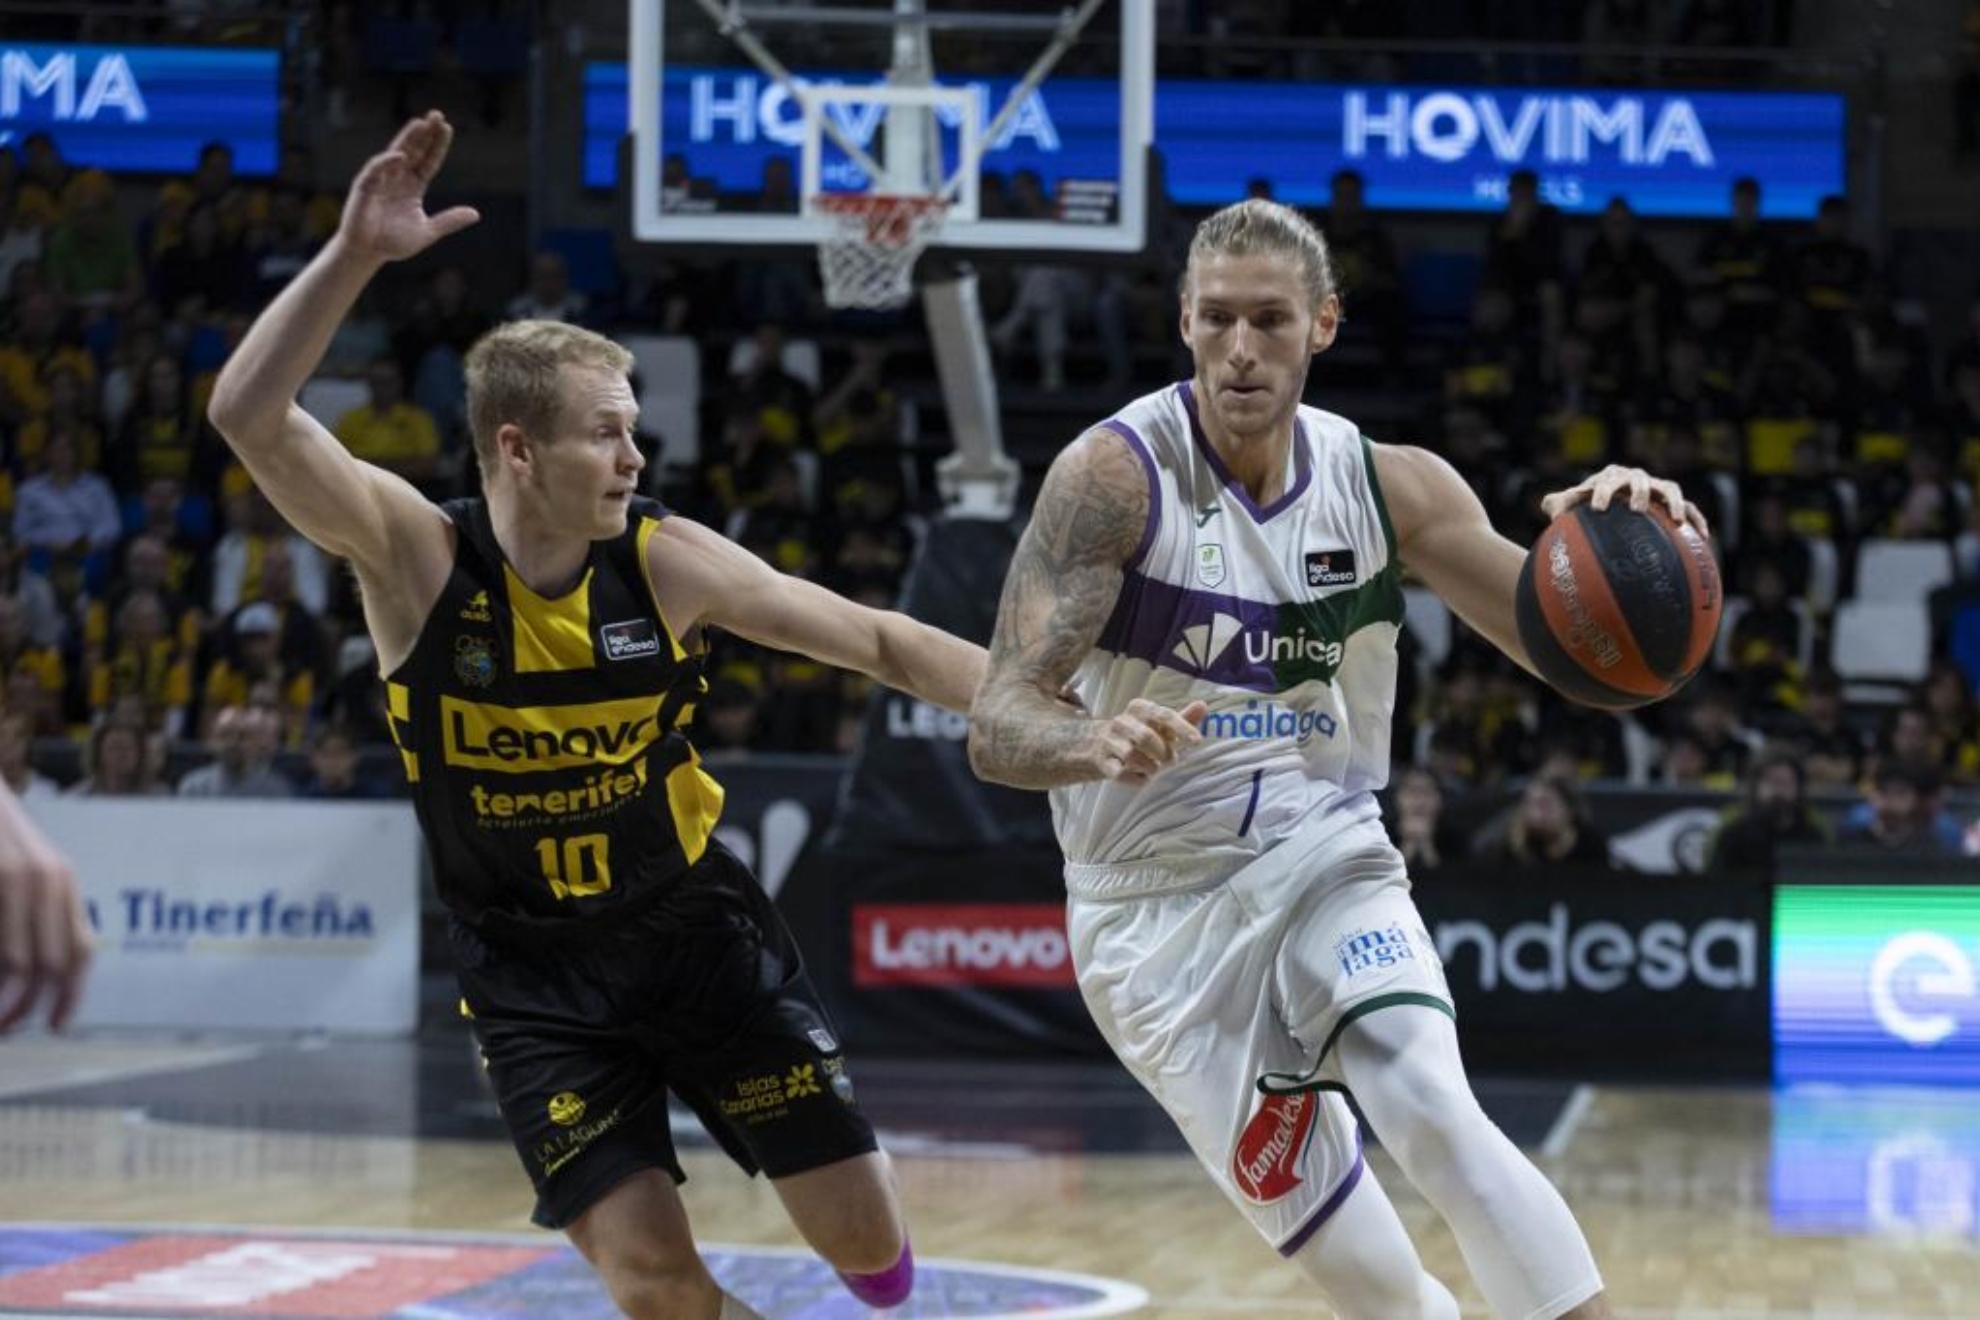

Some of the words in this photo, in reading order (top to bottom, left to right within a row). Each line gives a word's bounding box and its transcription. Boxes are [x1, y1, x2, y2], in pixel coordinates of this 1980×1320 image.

[1343, 92, 1716, 167] HOVIMA
[1244, 628, 1343, 668] Unica
[1201, 699, 1338, 743] málaga
[535, 833, 612, 901] 10
[120, 886, 373, 938] Tinerfeña
[870, 919, 1067, 970] Lenovo
